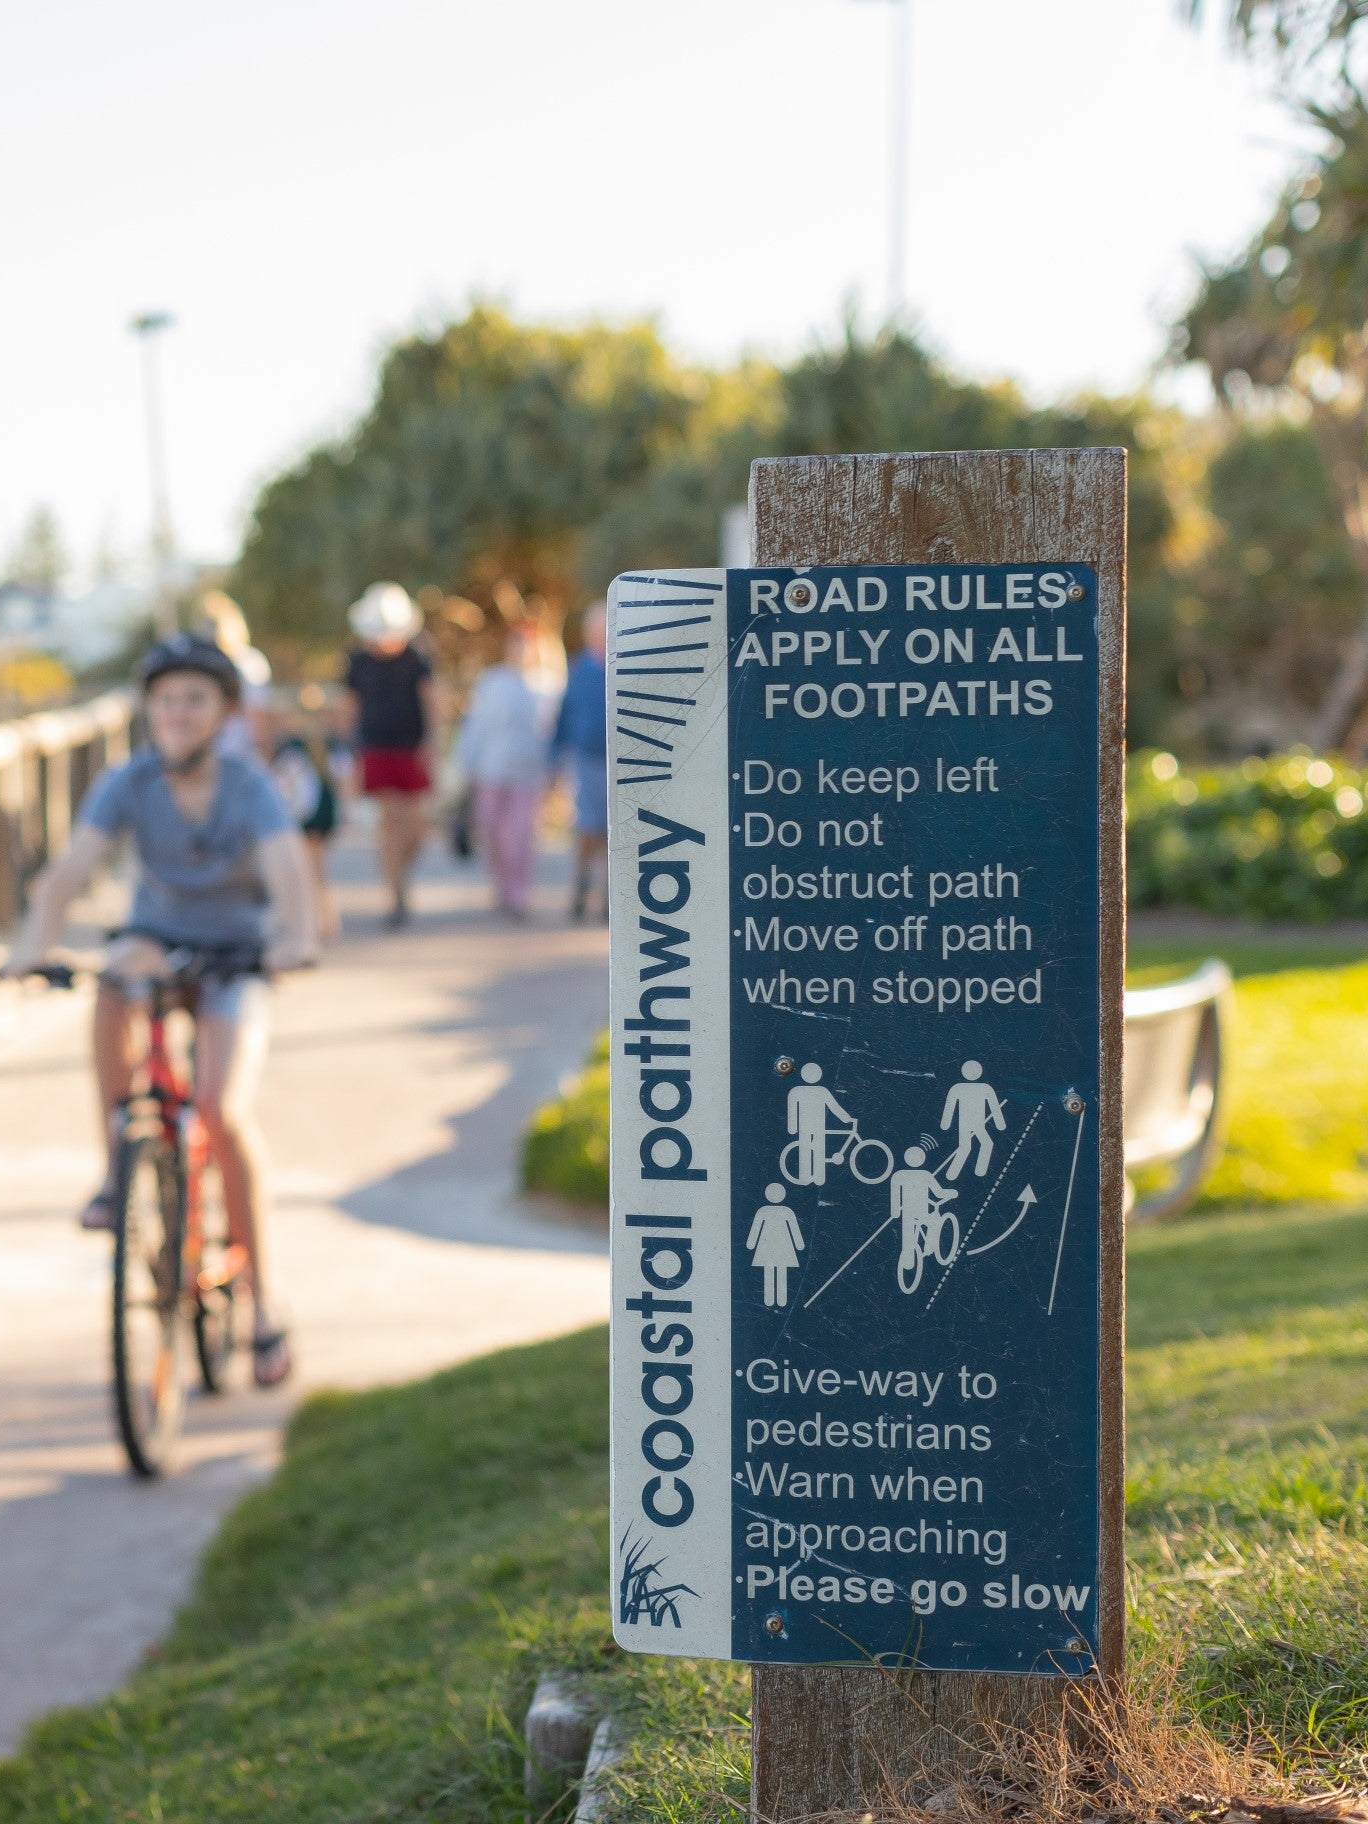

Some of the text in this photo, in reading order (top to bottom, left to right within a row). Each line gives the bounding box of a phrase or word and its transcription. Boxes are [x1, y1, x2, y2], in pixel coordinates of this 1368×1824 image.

[749, 573, 1068, 614] ROAD RULES
[735, 627, 1083, 667] APPLY ON ALL
[765, 680, 1053, 719] FOOTPATHS
[819, 759, 919, 801] keep
[937, 756, 998, 793] left
[819, 812, 884, 846] not
[743, 864, 1019, 906] obstruct path
[874, 916, 928, 951] off
[942, 916, 1032, 959] path
[743, 970, 1041, 1012] when stopped
[624, 808, 707, 1527] coastal pathway
[958, 1365, 997, 1400] to
[747, 1413, 992, 1452] pedestrians
[870, 1468, 983, 1503] when
[746, 1519, 1006, 1565] approaching
[911, 1578, 967, 1614] go
[983, 1575, 1090, 1611] slow
